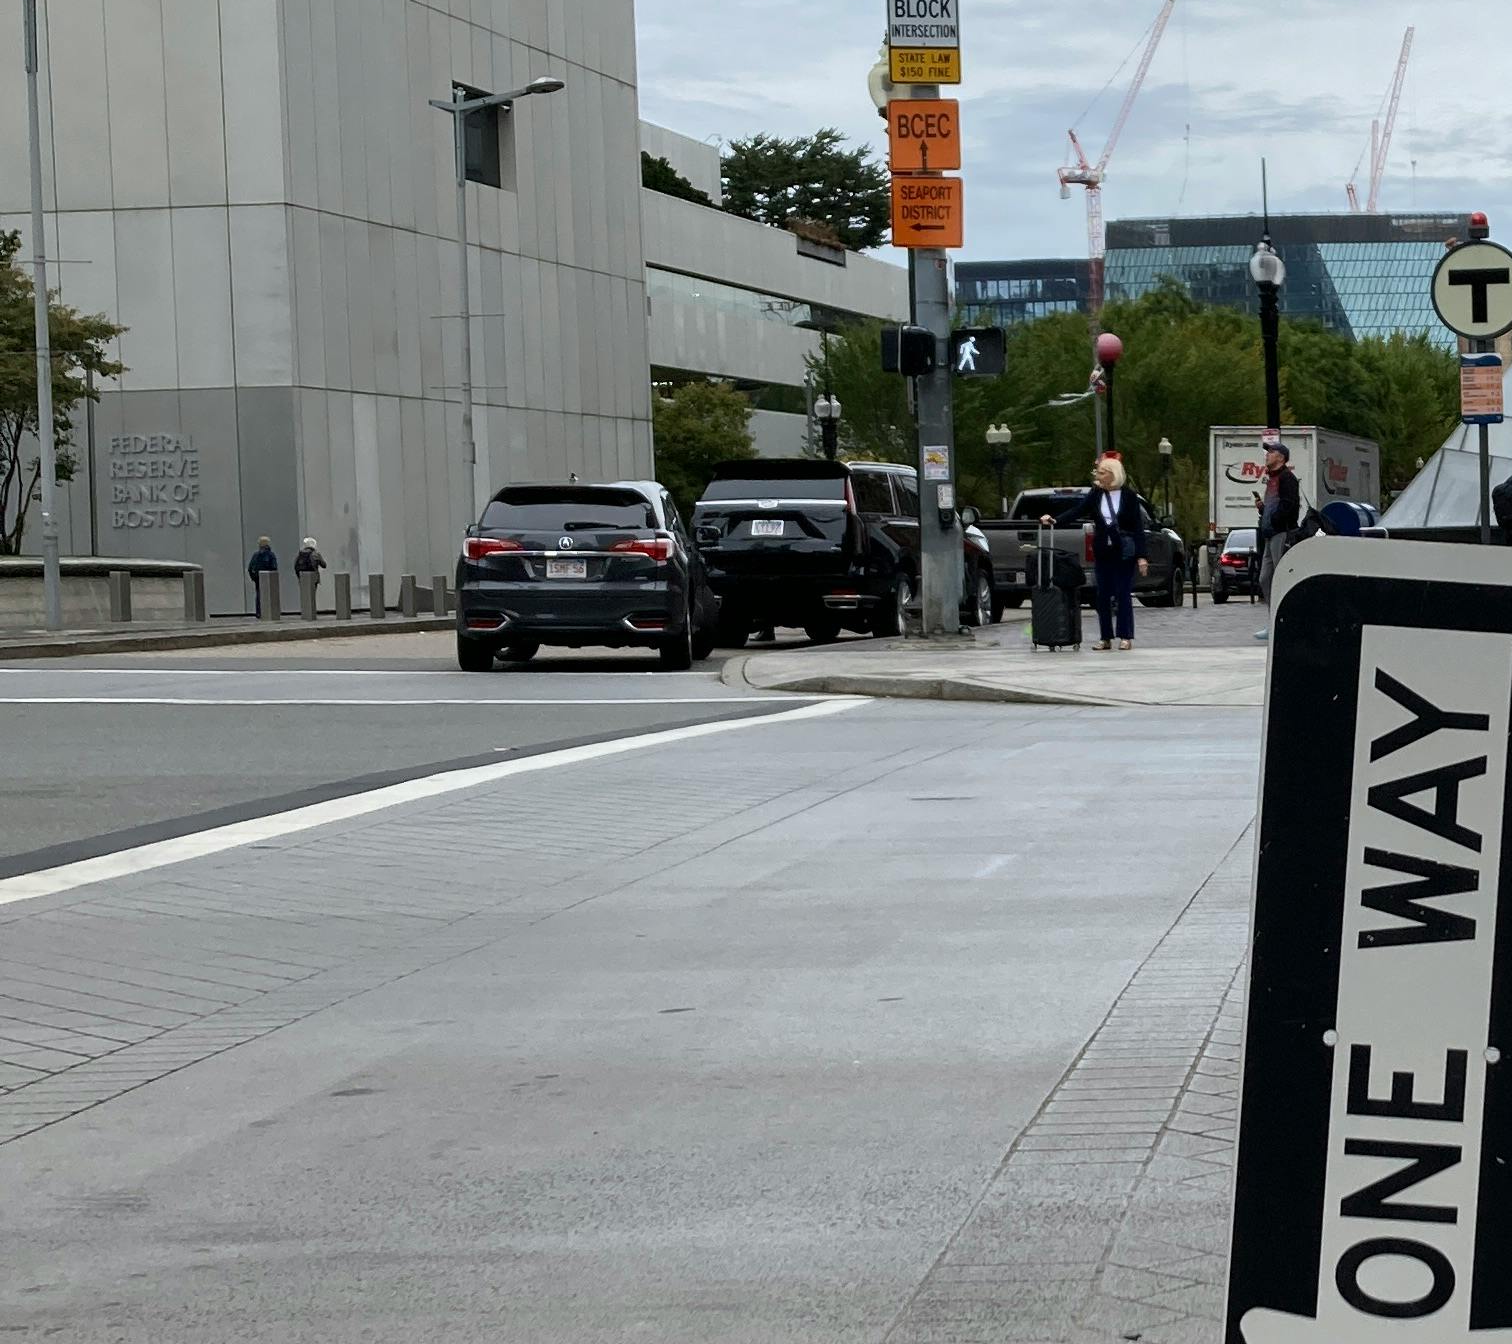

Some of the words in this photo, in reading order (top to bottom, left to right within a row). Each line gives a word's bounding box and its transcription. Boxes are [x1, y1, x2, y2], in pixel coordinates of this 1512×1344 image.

[891, 24, 957, 38] INTERSECTION
[898, 53, 926, 64] STATE
[931, 53, 951, 64] LAW
[900, 67, 924, 78] $150
[928, 67, 950, 78] FINE
[897, 113, 951, 139] BCEC
[900, 185, 952, 200] SEAPORT
[901, 205, 952, 220] DISTRICT
[1448, 268, 1510, 323] T
[110, 434, 199, 455] FEDERAL
[111, 459, 200, 480] RESERVE
[112, 484, 168, 504] BANK
[173, 484, 200, 503] OF
[112, 508, 201, 529] BOSTON
[1358, 666, 1490, 949] WAY
[1335, 1043, 1468, 1319] ONE
